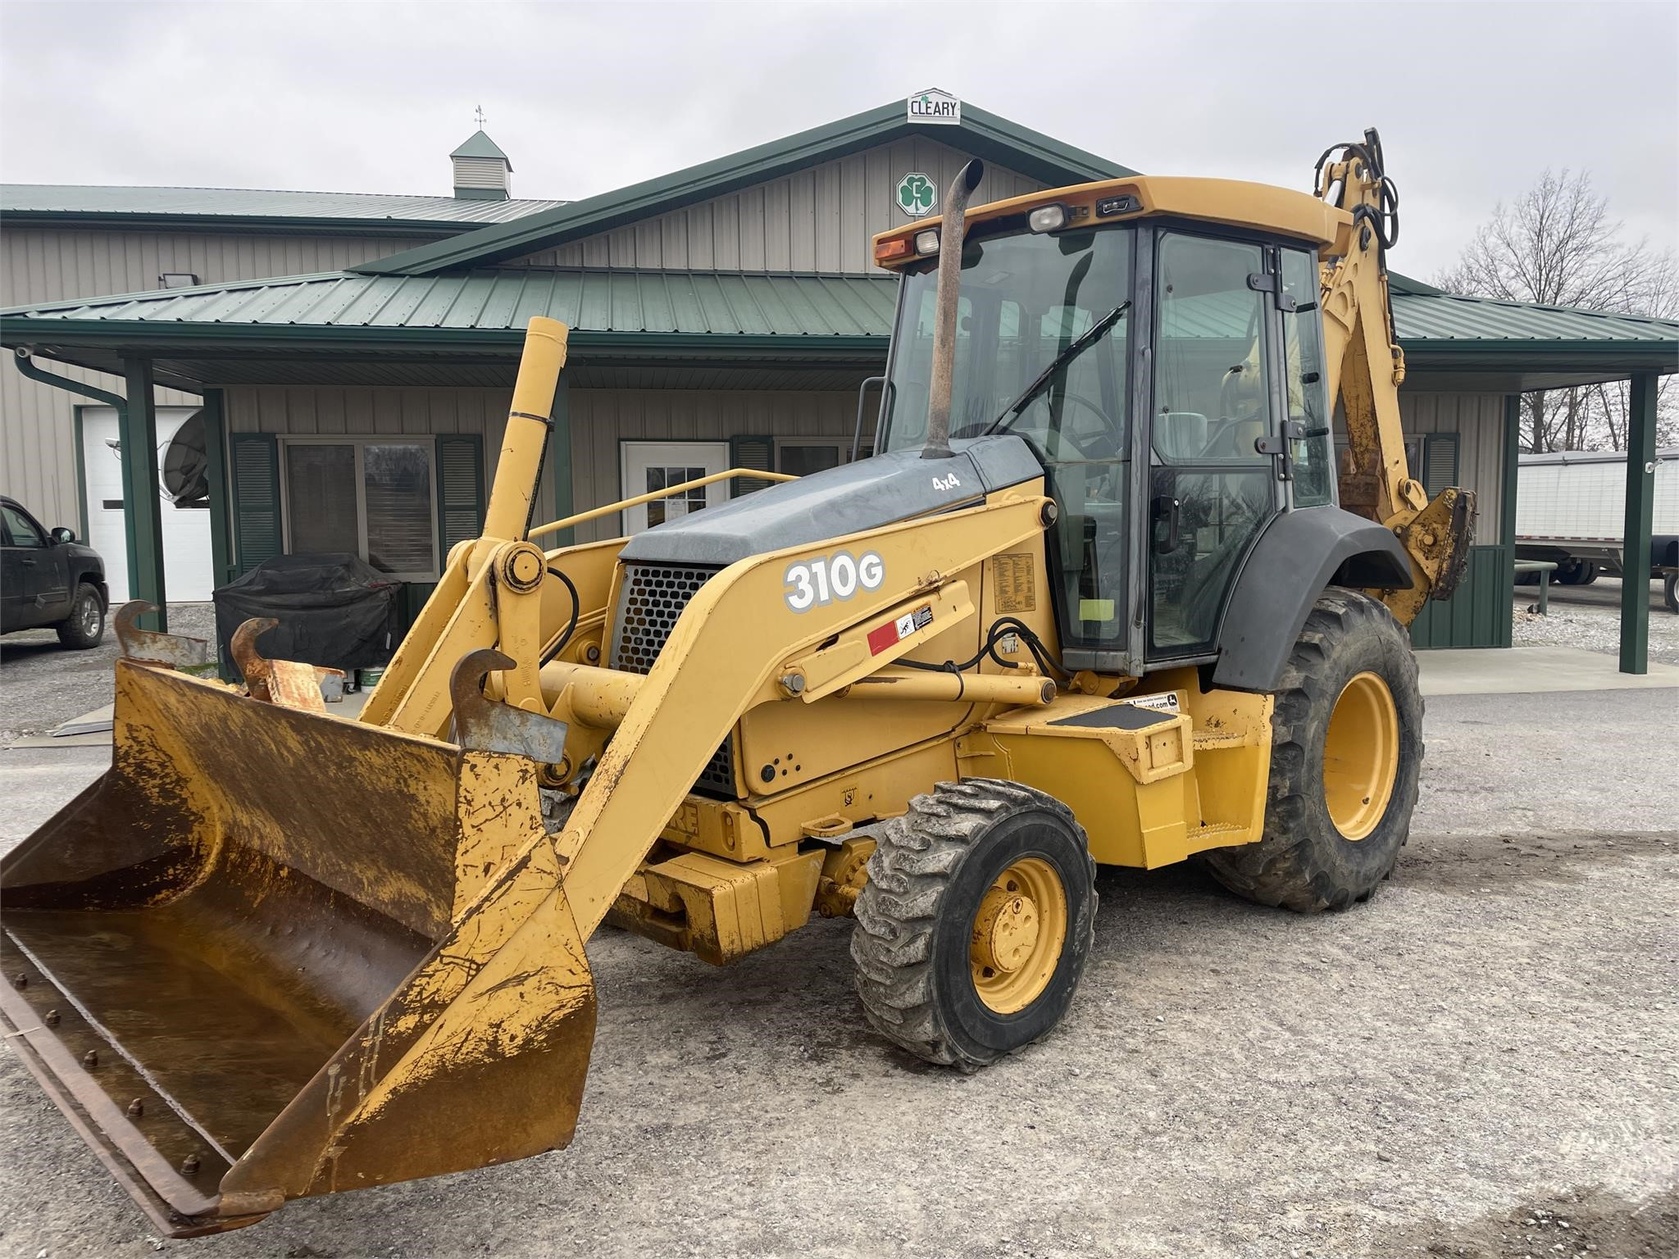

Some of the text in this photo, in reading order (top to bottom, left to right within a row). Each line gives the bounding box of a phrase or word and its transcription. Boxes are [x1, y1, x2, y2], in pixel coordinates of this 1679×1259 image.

[911, 100, 957, 116] CLEARY
[932, 472, 961, 491] 4x4
[787, 554, 883, 609] 310G
